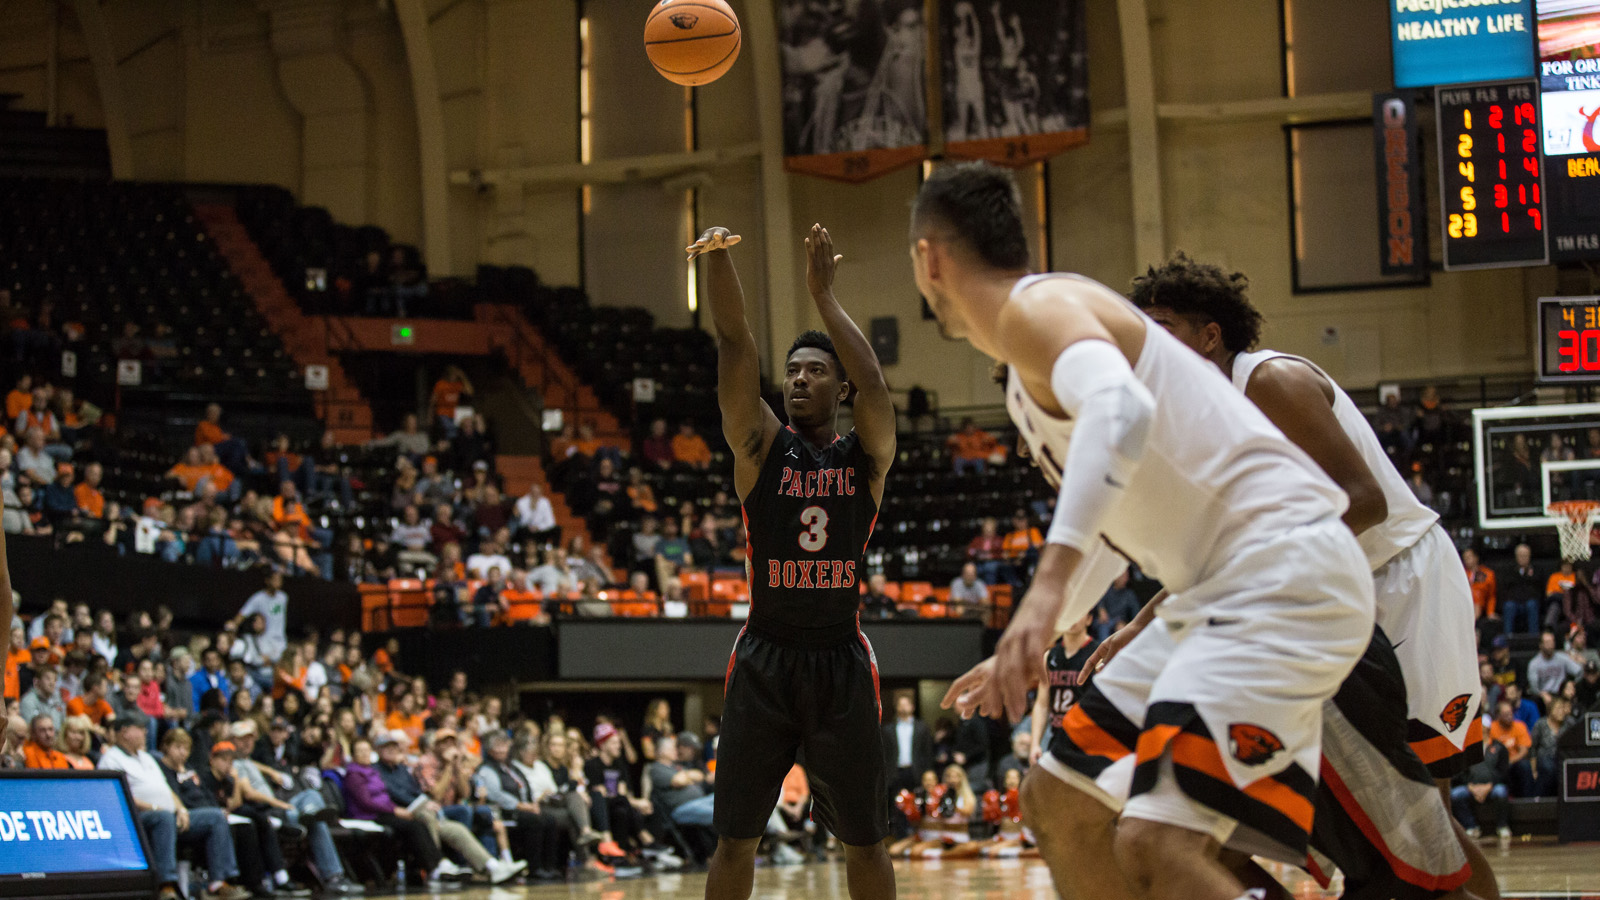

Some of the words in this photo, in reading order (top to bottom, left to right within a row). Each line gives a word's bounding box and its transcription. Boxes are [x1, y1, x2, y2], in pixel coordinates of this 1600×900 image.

[1397, 16, 1480, 41] HEALTHY
[1487, 13, 1526, 33] LIFE
[1542, 60, 1574, 76] FOR
[1476, 88, 1499, 102] FLS
[1508, 85, 1531, 100] PTS
[1464, 108, 1472, 129] 1
[1488, 105, 1503, 128] 2
[1514, 103, 1535, 125] 19
[1458, 134, 1473, 158] 2
[1497, 133, 1505, 153] 1
[1522, 129, 1537, 153] 2
[1382, 98, 1413, 265] OREGON
[1459, 161, 1475, 182] 4
[1499, 159, 1507, 179] 1
[1523, 157, 1538, 177] 4
[1460, 186, 1476, 210] 5
[1494, 184, 1508, 208] 3
[1519, 183, 1540, 204] 11
[1448, 213, 1477, 238] 23
[1502, 212, 1509, 232] 1
[1528, 208, 1541, 230] 7
[1556, 235, 1575, 251] TM
[1577, 233, 1599, 250] FLS
[1558, 329, 1600, 371] 30
[778, 466, 856, 498] PACIFIC
[798, 505, 830, 552] 3
[768, 559, 856, 589] BOXERS
[1053, 688, 1074, 712] 12
[0, 811, 30, 842] DE
[26, 810, 112, 841] TRAVEL
